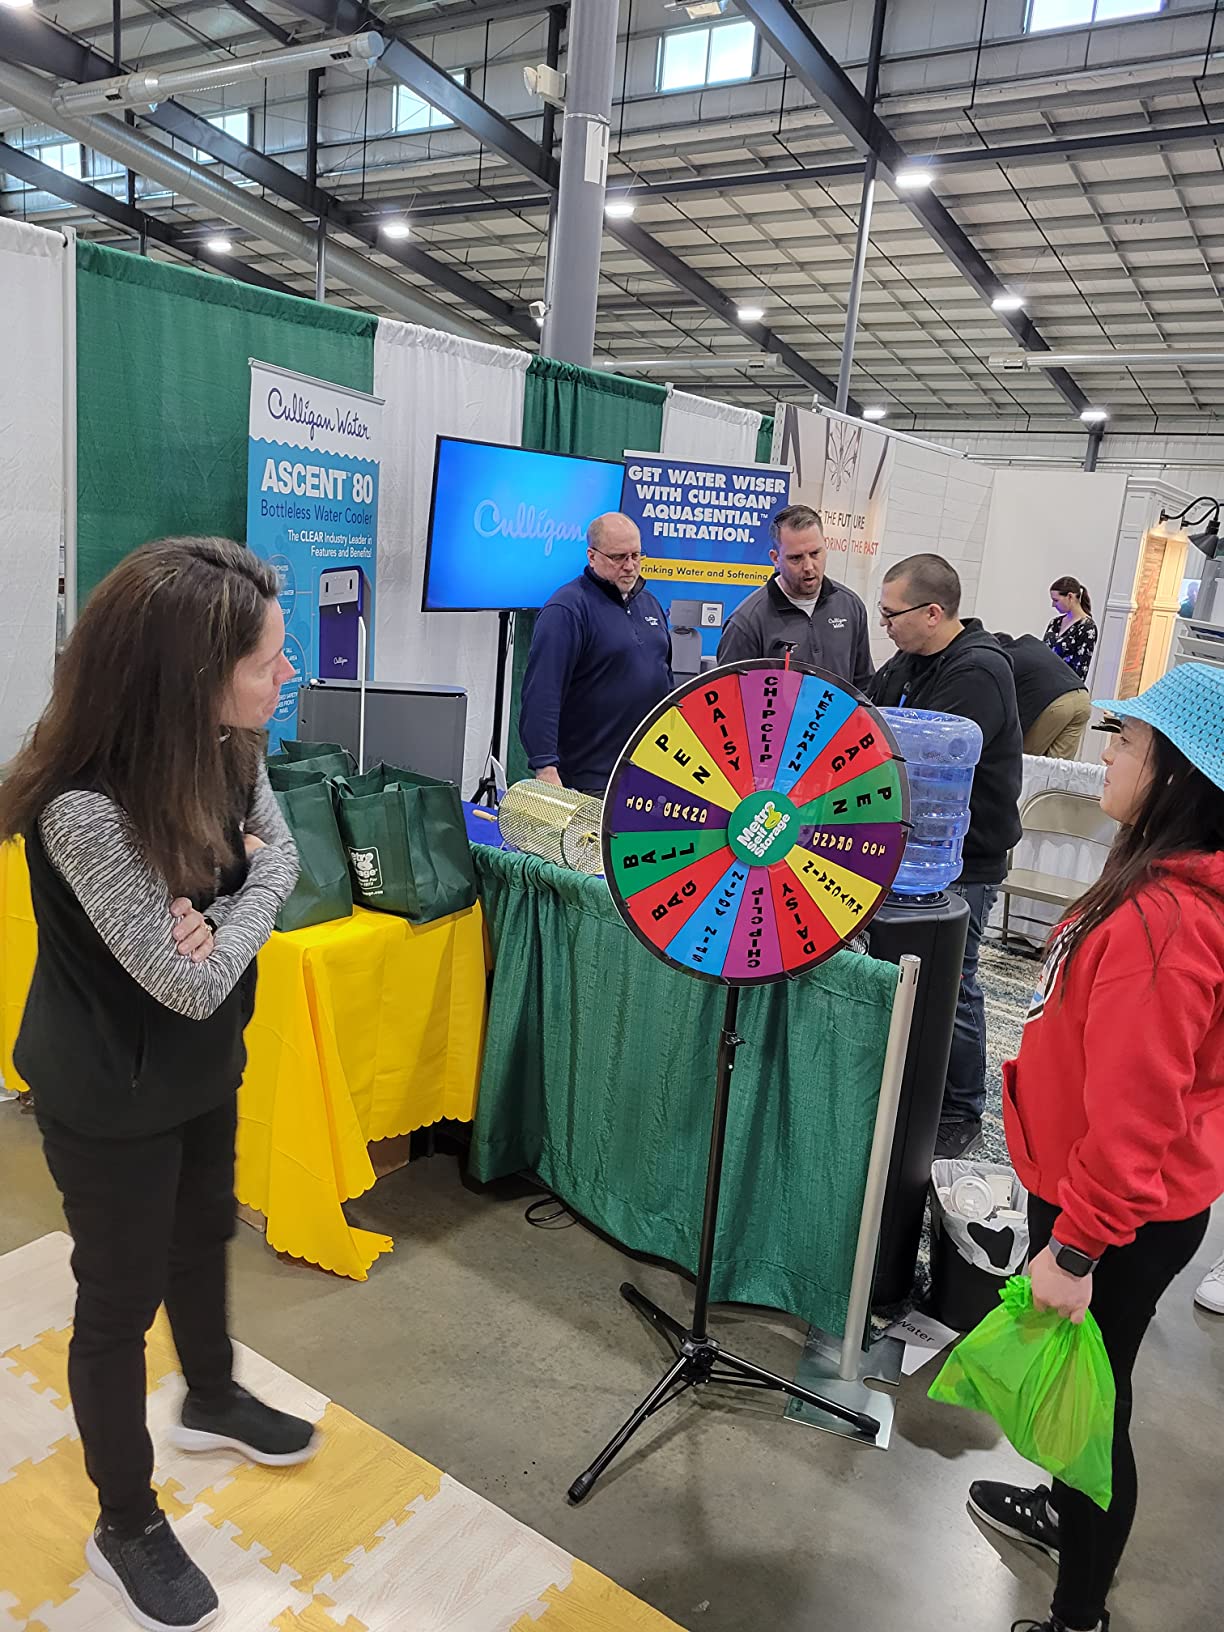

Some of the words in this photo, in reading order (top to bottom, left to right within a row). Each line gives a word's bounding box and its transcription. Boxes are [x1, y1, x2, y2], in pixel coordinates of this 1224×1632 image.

[267, 387, 336, 441] Culligan
[335, 407, 370, 440] Water
[352, 472, 373, 504] 80
[628, 465, 663, 483] GET
[667, 469, 727, 488] WATER
[732, 474, 786, 494] WISER
[636, 484, 682, 502] WITH
[261, 498, 311, 521] Bottleless
[314, 504, 343, 523] Water
[344, 507, 373, 525] Cooler
[824, 510, 837, 526] THE
[288, 529, 299, 542] The
[300, 530, 324, 543] CLEAR
[324, 532, 348, 547] Industry
[348, 534, 367, 545] Leader
[367, 535, 373, 545] in
[473, 499, 588, 557] Culligan
[653, 521, 755, 544] FILTRATION.
[311, 545, 337, 558] Features
[338, 547, 349, 558] and
[851, 539, 863, 554] THE
[863, 541, 879, 556] PAST
[640, 565, 673, 577] rinking
[676, 566, 704, 577] Water
[706, 569, 725, 578] and
[727, 568, 768, 583] Softening
[704, 690, 741, 772] DAISY
[788, 689, 835, 772] KEYCHAIN
[654, 733, 711, 785] PEN
[831, 732, 875, 773] BAG
[832, 786, 892, 815] PEN
[736, 801, 776, 847] Metro
[746, 826, 768, 853] Self
[753, 814, 791, 858] Storage
[623, 842, 695, 870] BALL
[651, 880, 697, 922] BAG
[802, 860, 864, 916] KEYCHAIN
[691, 926, 718, 963] SPIN
[714, 870, 745, 917] AGAIN
[781, 882, 817, 955] DAISY
